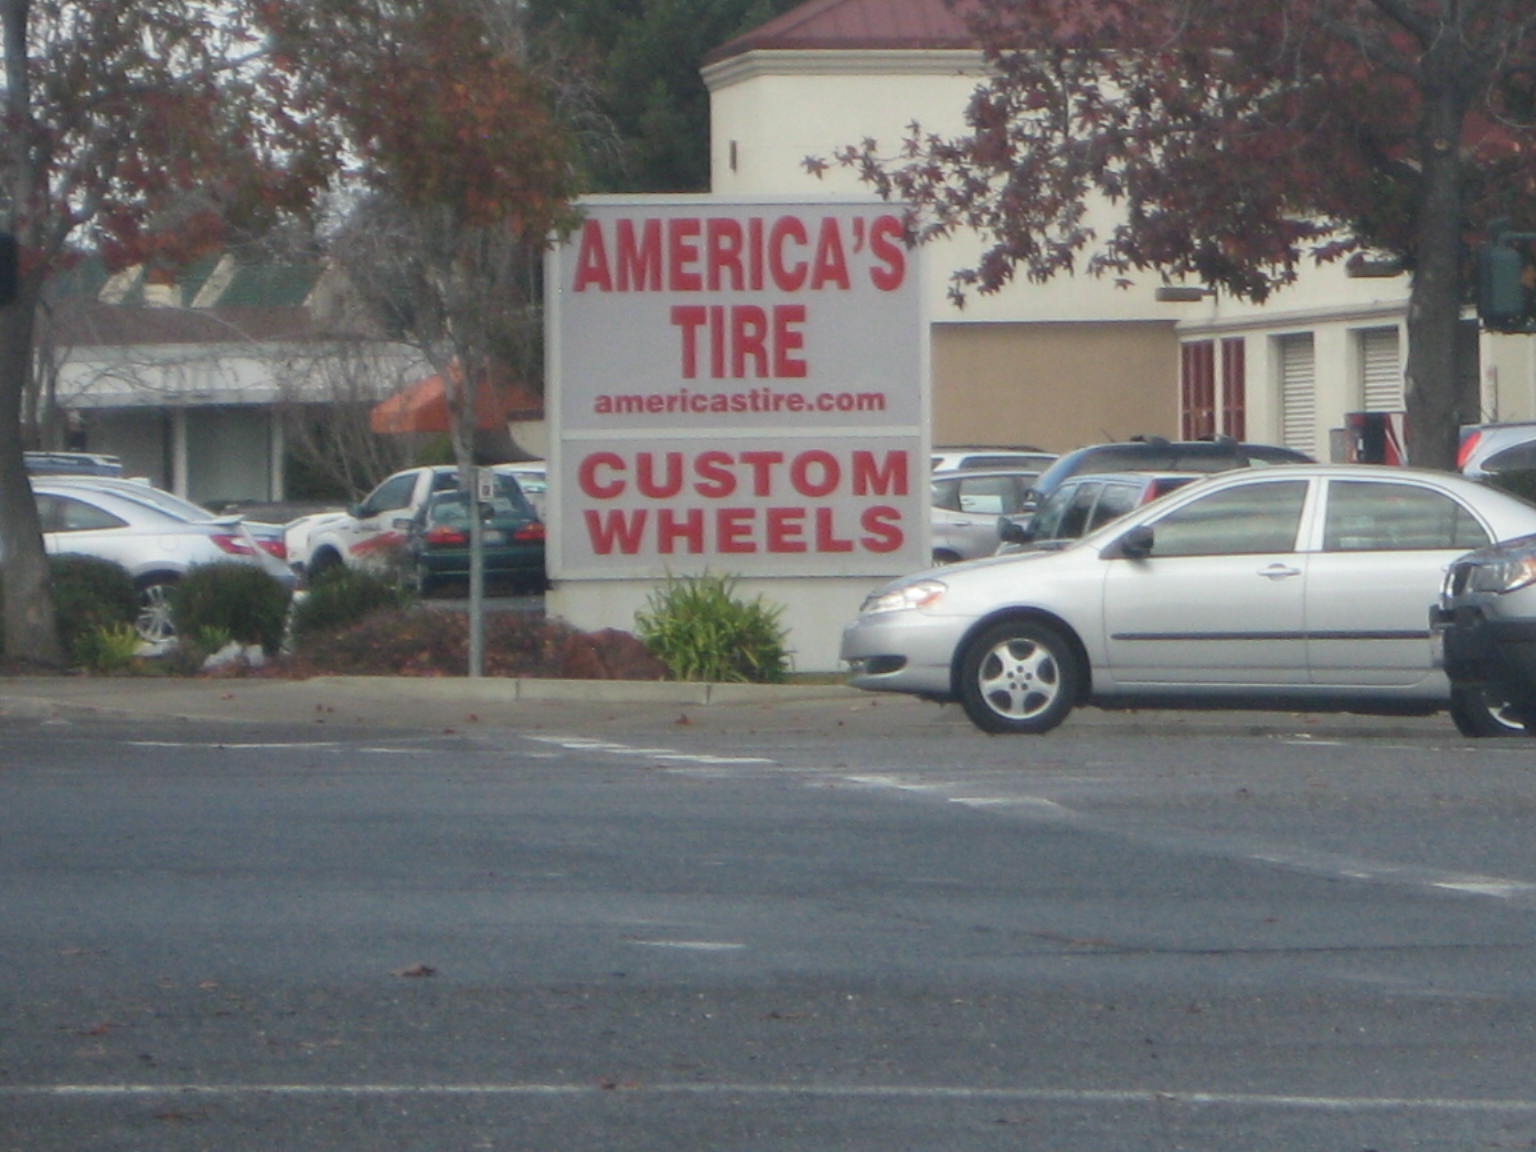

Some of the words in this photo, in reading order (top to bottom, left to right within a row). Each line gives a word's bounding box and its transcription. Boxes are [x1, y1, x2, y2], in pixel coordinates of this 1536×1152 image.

[572, 214, 907, 293] AMERICA'S
[670, 304, 808, 379] TIRE
[594, 388, 886, 415] americastire.com
[577, 448, 910, 500] CUSTOM
[583, 504, 905, 555] WHEELS
